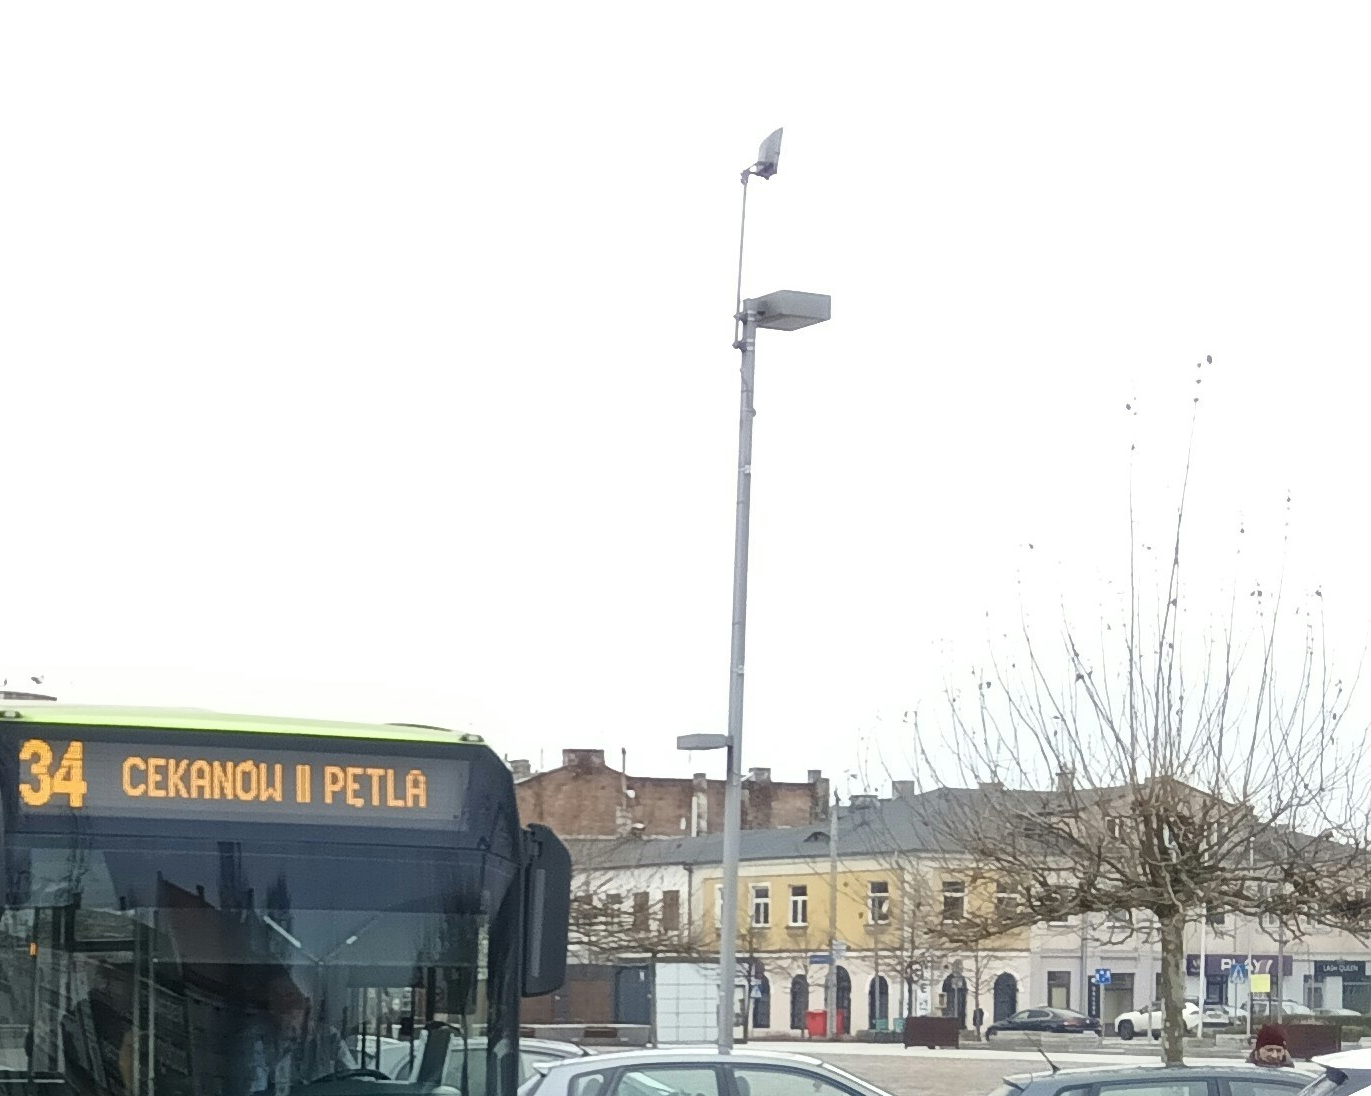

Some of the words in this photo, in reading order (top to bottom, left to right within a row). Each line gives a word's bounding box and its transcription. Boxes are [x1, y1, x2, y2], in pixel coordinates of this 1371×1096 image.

[19, 738, 88, 808] 34
[122, 756, 283, 802] CEKANÓW
[296, 764, 311, 803] II
[324, 765, 427, 808] PĘTLA
